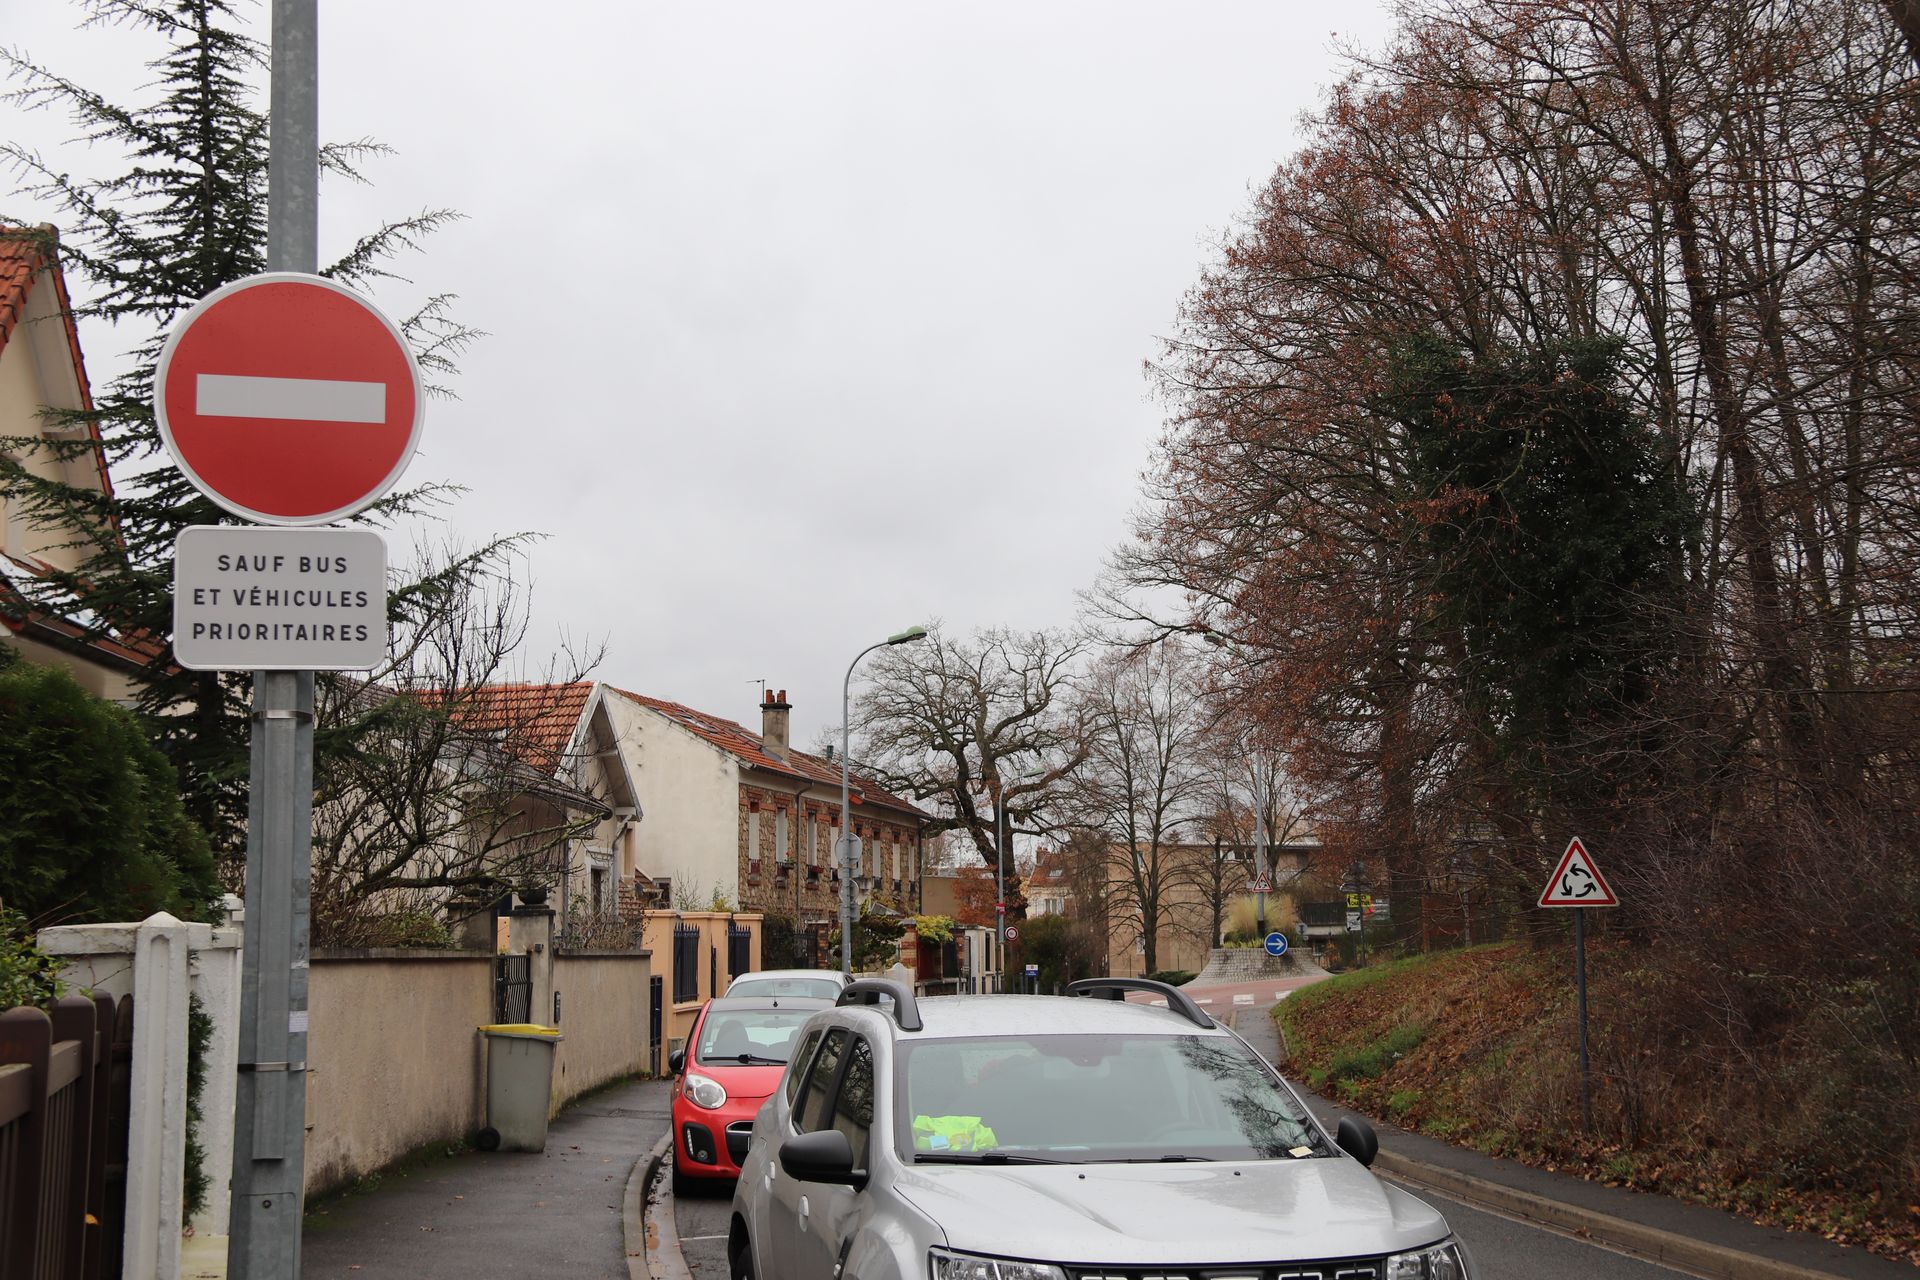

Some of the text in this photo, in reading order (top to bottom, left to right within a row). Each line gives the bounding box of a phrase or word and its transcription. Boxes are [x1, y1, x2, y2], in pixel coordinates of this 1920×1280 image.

[217, 555, 348, 574] SAUF BUS
[193, 586, 368, 607] ET VÉHICULES
[192, 623, 368, 641] PRIORITAIRES
